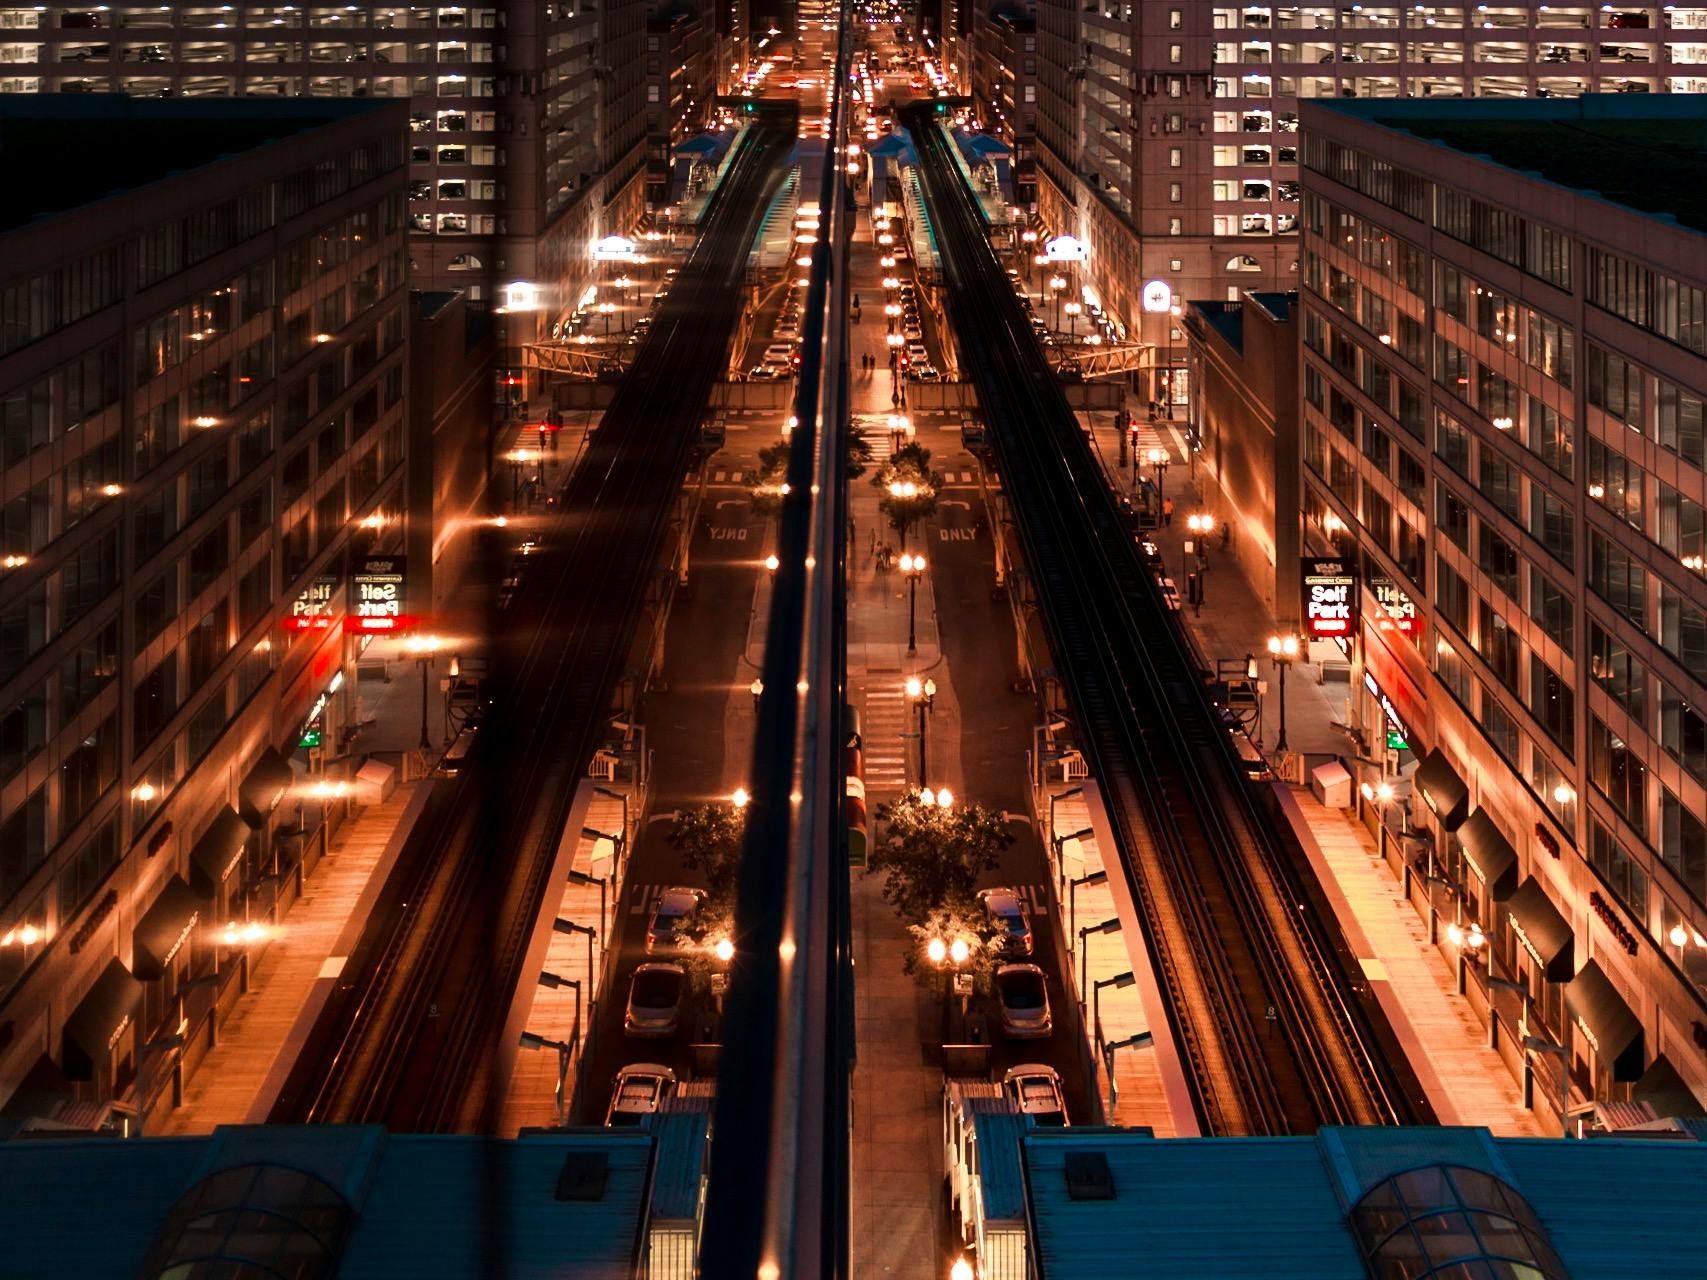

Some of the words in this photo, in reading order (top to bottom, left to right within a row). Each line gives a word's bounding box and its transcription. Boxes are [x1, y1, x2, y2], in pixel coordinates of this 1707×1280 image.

[940, 527, 976, 541] ONLY
[1311, 585, 1347, 602] Self
[1308, 602, 1350, 619] Park
